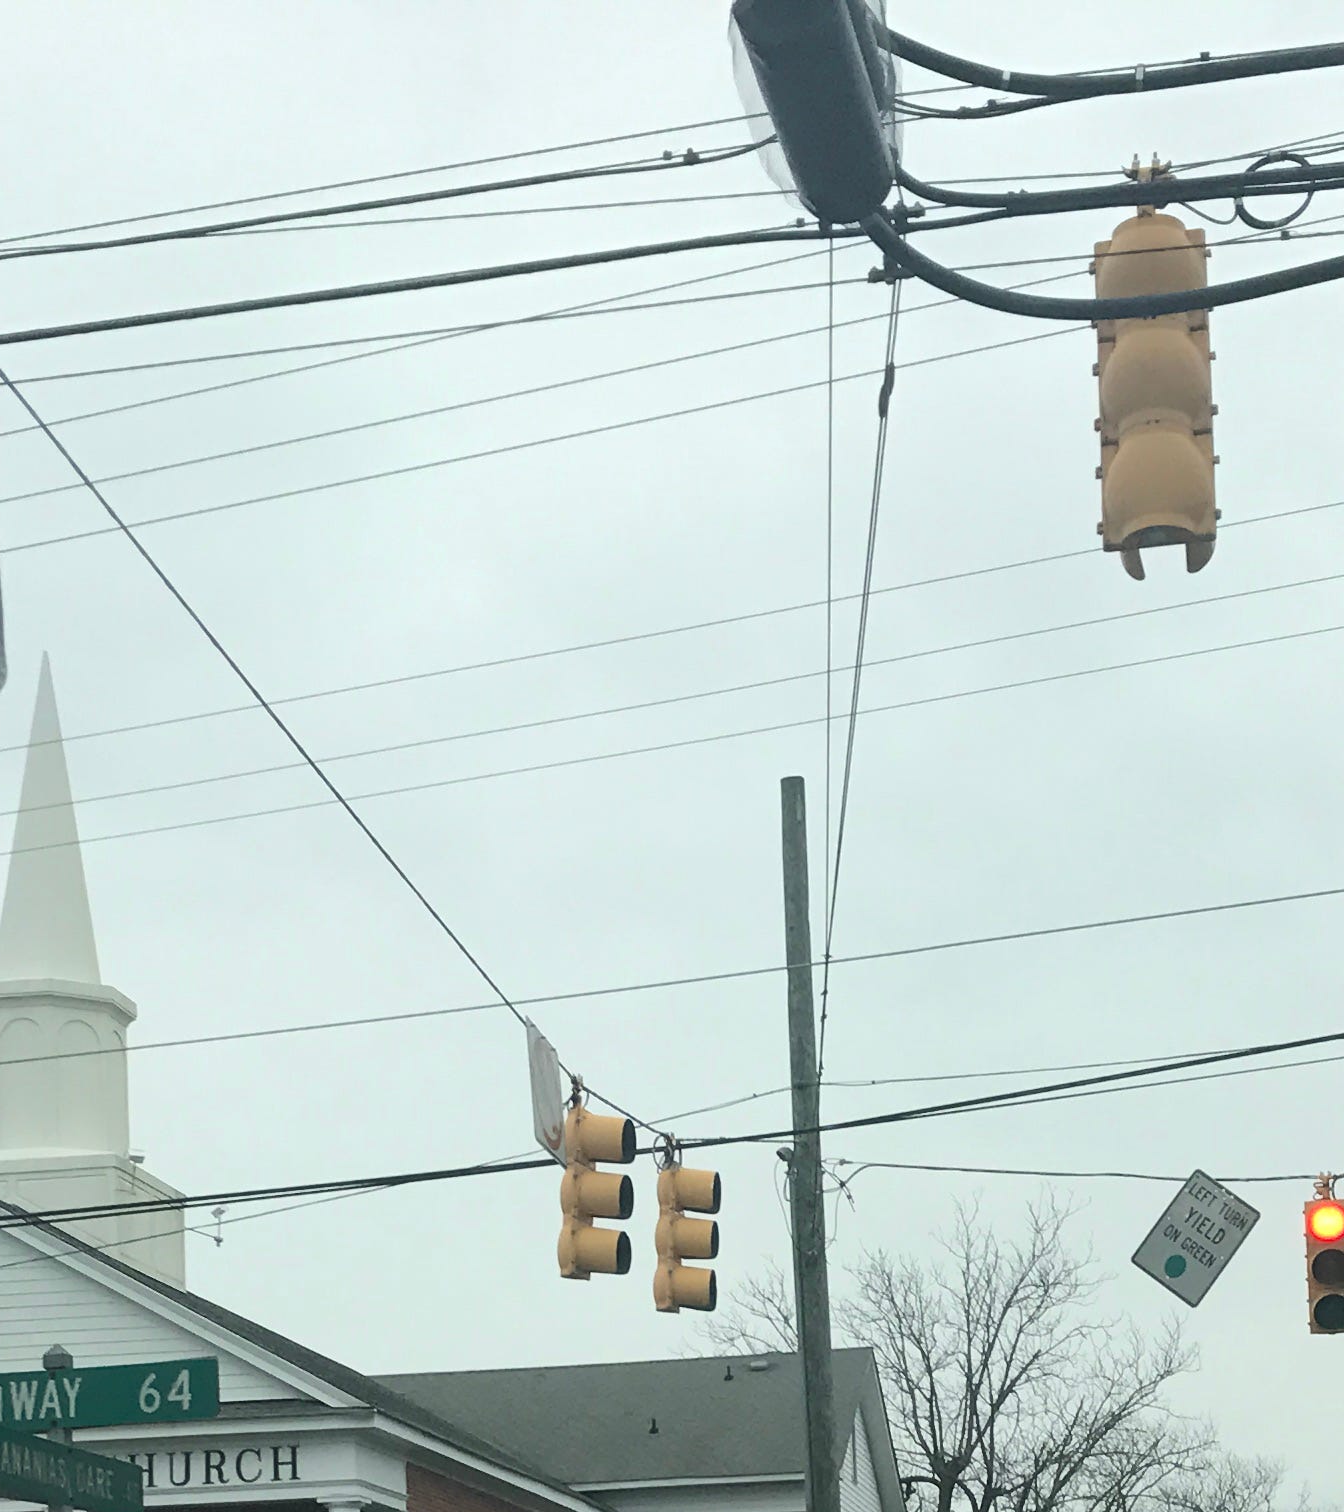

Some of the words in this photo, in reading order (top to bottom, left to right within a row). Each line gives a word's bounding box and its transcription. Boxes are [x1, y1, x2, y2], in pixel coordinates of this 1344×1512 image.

[1184, 1206, 1226, 1245] YIELD
[1188, 1182, 1218, 1208] LEFT
[1218, 1202, 1249, 1231] TURN
[1163, 1224, 1181, 1243] ON
[1181, 1236, 1218, 1268] GREEN
[138, 1368, 193, 1415] 64
[1, 1440, 67, 1489] ANANIAS
[76, 1461, 116, 1501] DARE
[127, 1440, 302, 1488] HURCH
